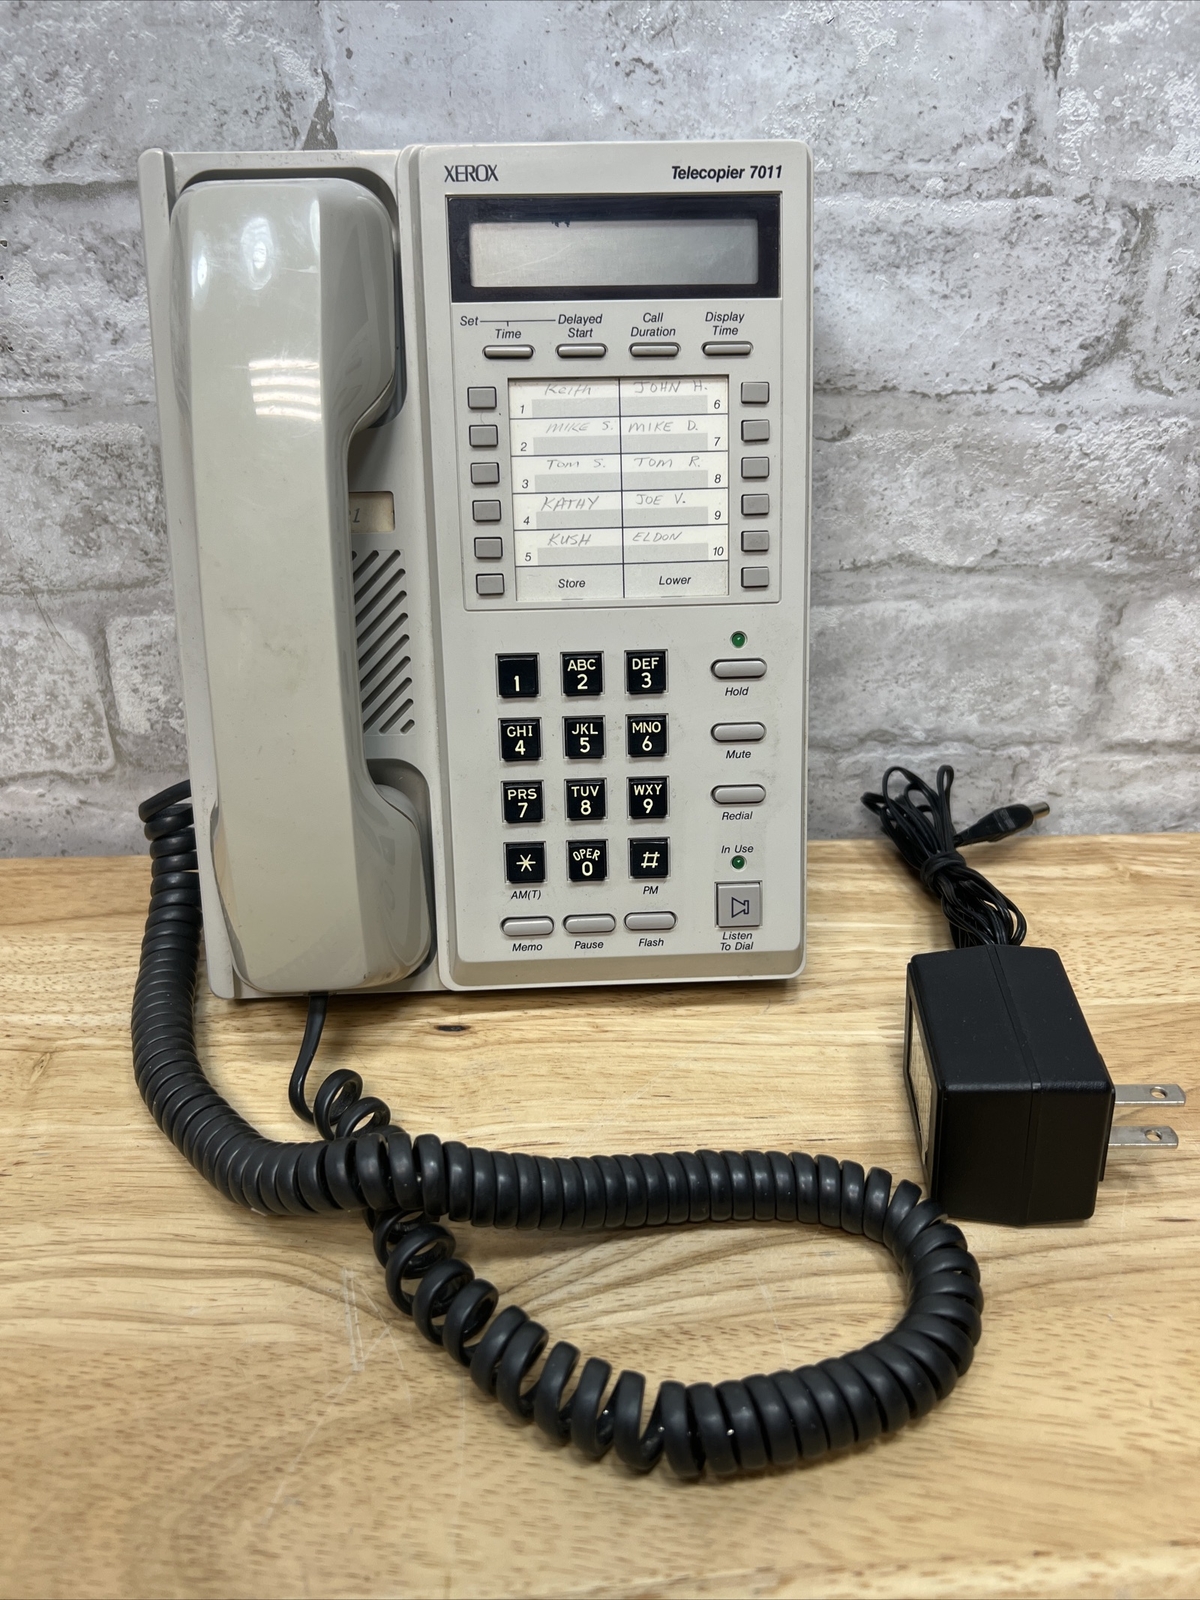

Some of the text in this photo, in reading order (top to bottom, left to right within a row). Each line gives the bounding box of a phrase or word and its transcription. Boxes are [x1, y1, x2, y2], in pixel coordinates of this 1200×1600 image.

[444, 164, 499, 182] XEROX
[671, 165, 783, 182] Telecopier 7011
[460, 316, 479, 326] Set
[558, 314, 603, 326] Delayed
[643, 312, 664, 324] Call
[705, 311, 745, 325] Display
[495, 328, 522, 339] Time
[567, 327, 594, 338] Start
[630, 326, 676, 338] Duration
[712, 325, 739, 337] Time
[633, 379, 708, 394] JOHN H.
[519, 403, 526, 415] 1
[712, 399, 722, 410] 6
[601, 420, 614, 432] S.
[628, 419, 699, 433] MIKE D.
[519, 441, 528, 452] 2
[713, 436, 722, 447] 7
[593, 457, 606, 469] S.
[688, 455, 701, 468] R.
[521, 479, 530, 490] 3
[713, 474, 722, 485] 8
[540, 495, 600, 512] KATHY
[635, 492, 687, 506] JOE V.
[522, 516, 531, 527] 4
[713, 510, 722, 521] 9
[524, 552, 533, 563] 5
[712, 546, 725, 558] 10
[557, 577, 587, 589] Store
[658, 574, 692, 587] Lower
[566, 658, 597, 671] ABC
[631, 657, 660, 670] DEF
[513, 675, 521, 692] 1
[576, 673, 589, 690] 2
[641, 672, 653, 689] 3
[724, 685, 750, 697] Hold
[506, 725, 534, 738] GHI
[571, 723, 599, 736] JKL
[632, 721, 662, 734] MNO
[514, 740, 527, 756] 4
[579, 737, 591, 754] 5
[641, 736, 653, 752] 6
[725, 749, 752, 760] Mute
[507, 789, 538, 801] PRS
[571, 786, 600, 798] TUV
[633, 784, 663, 797] WXY
[517, 802, 529, 819] 7
[580, 800, 592, 816] 8
[642, 798, 654, 814] 9
[722, 811, 753, 822] Redial
[572, 848, 601, 862] OPER
[720, 844, 754, 855] In Use
[581, 861, 593, 877] 0
[510, 889, 542, 900] AM(T)
[642, 885, 660, 895] PM
[638, 937, 665, 948] Flash
[722, 931, 753, 942] Listen
[511, 943, 543, 953] Memo
[574, 940, 604, 951] Pause
[720, 940, 754, 952] To Dial
